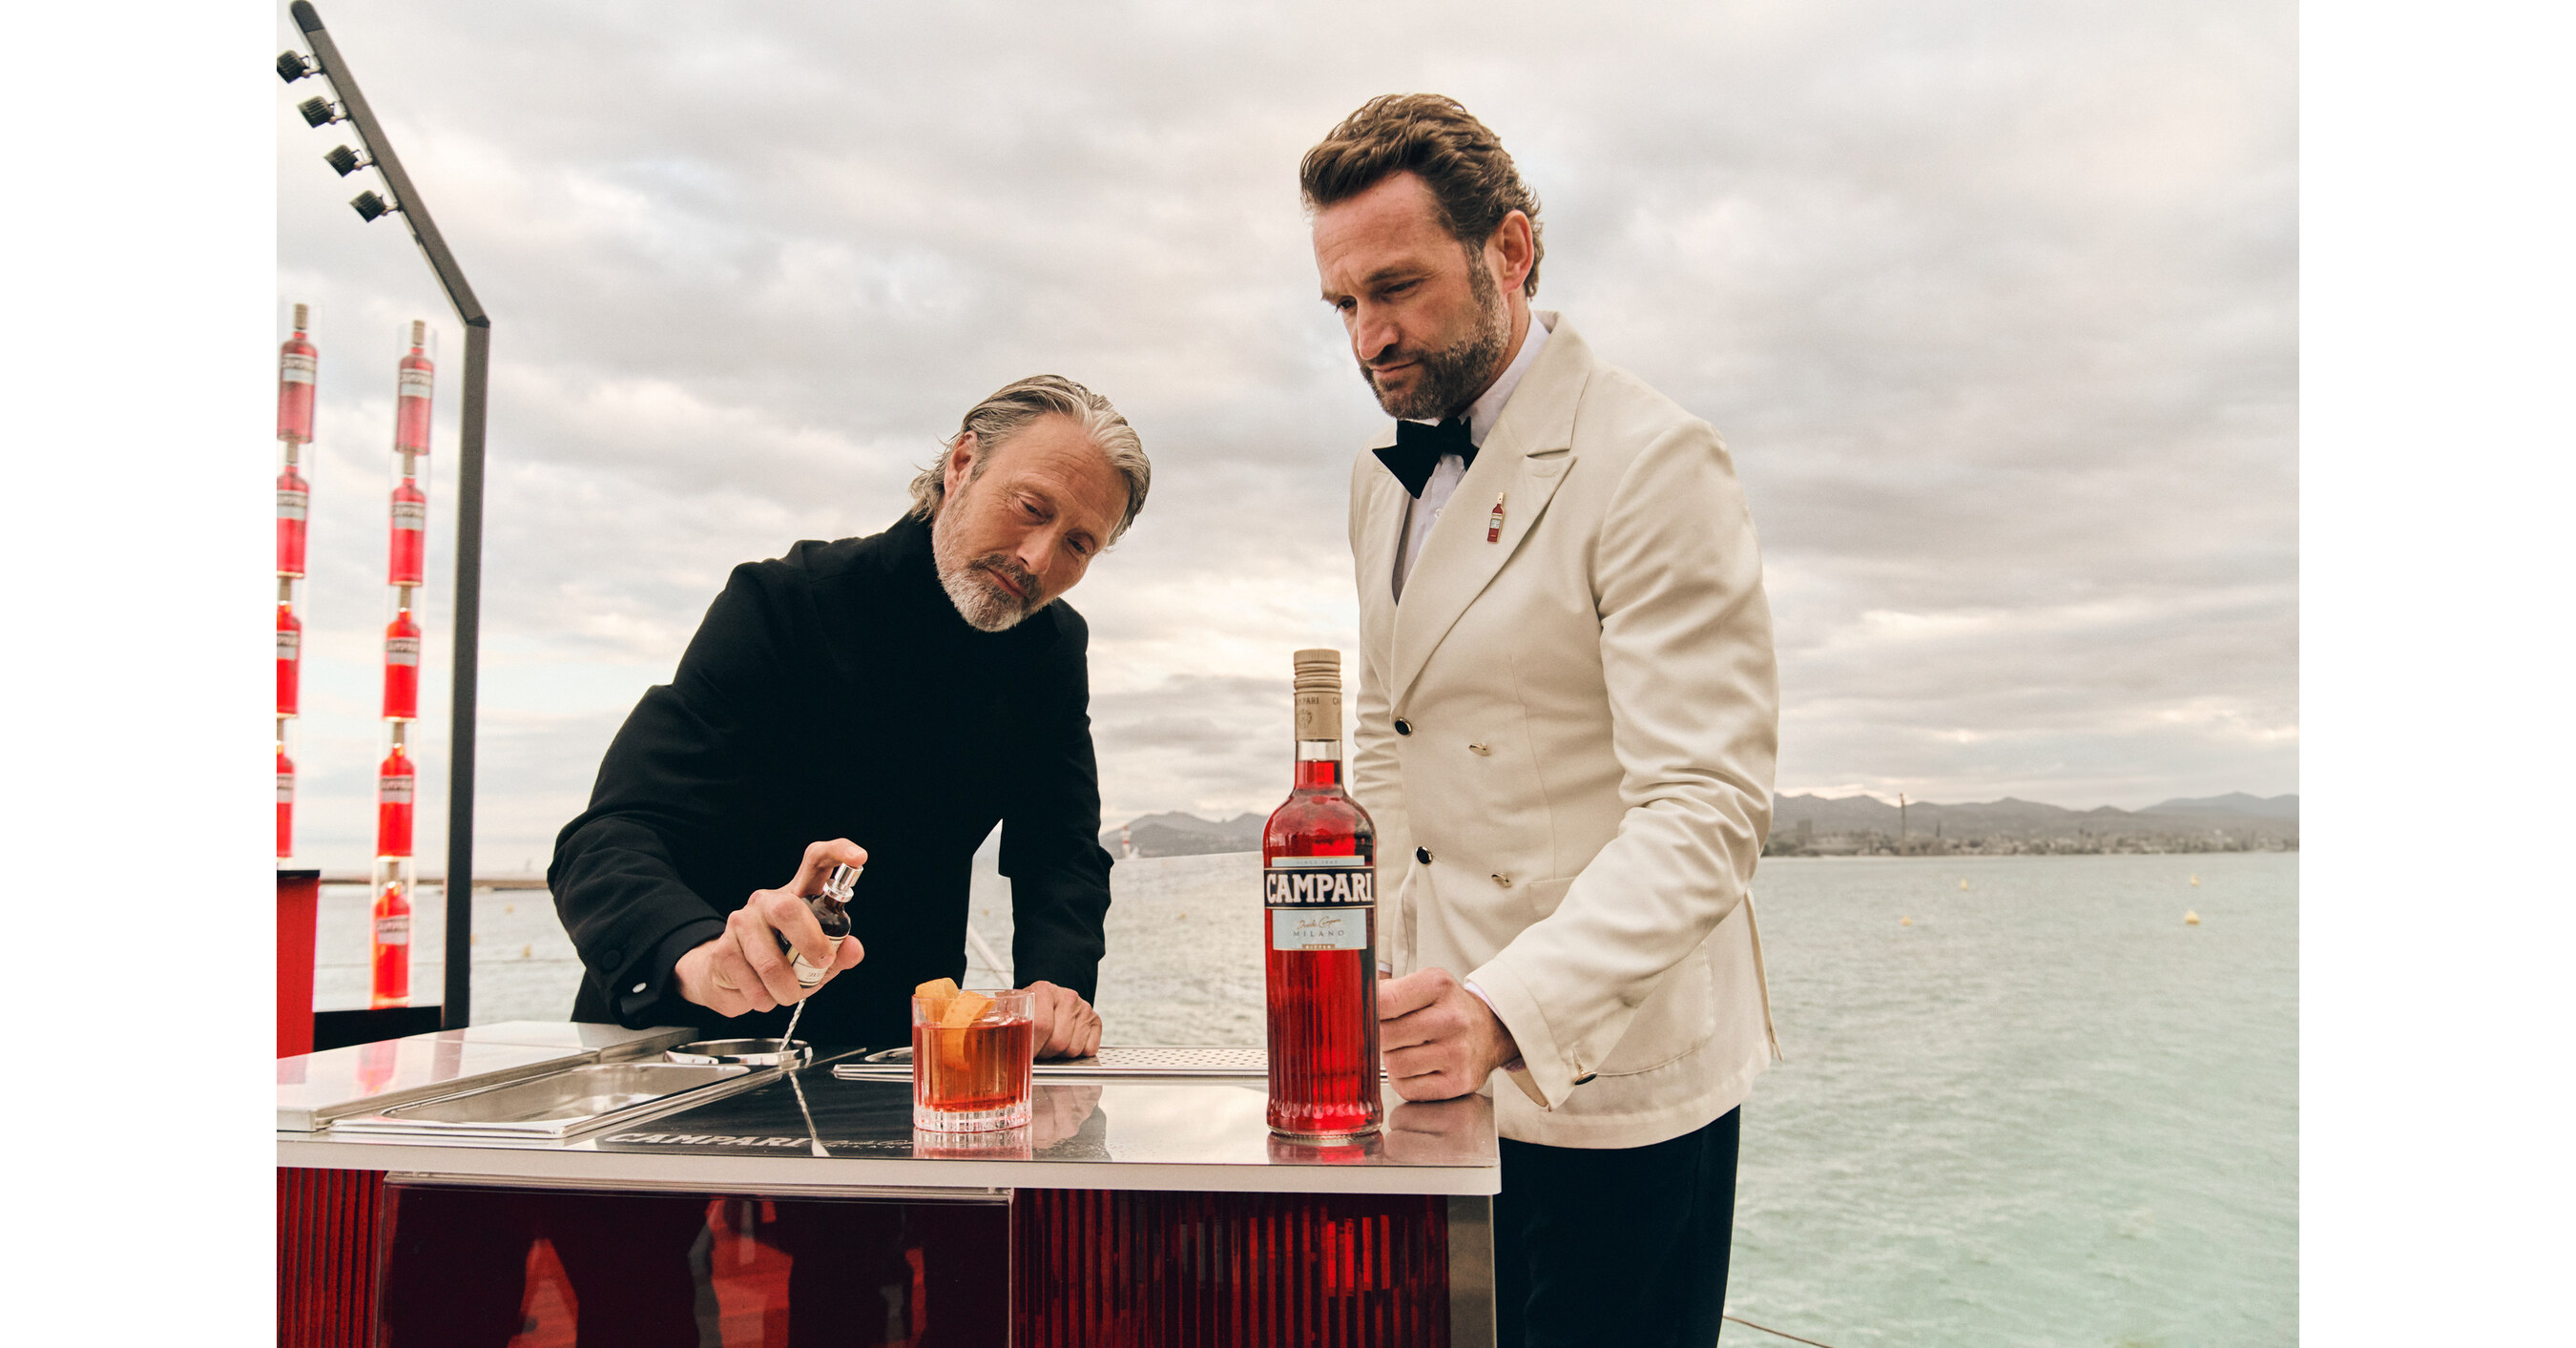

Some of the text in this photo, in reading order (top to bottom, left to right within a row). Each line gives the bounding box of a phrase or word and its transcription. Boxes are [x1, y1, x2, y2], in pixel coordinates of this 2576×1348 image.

[1266, 872, 1372, 903] CAMPARI
[1293, 929, 1345, 938] MILANO
[604, 1132, 813, 1148] CAMPARI
